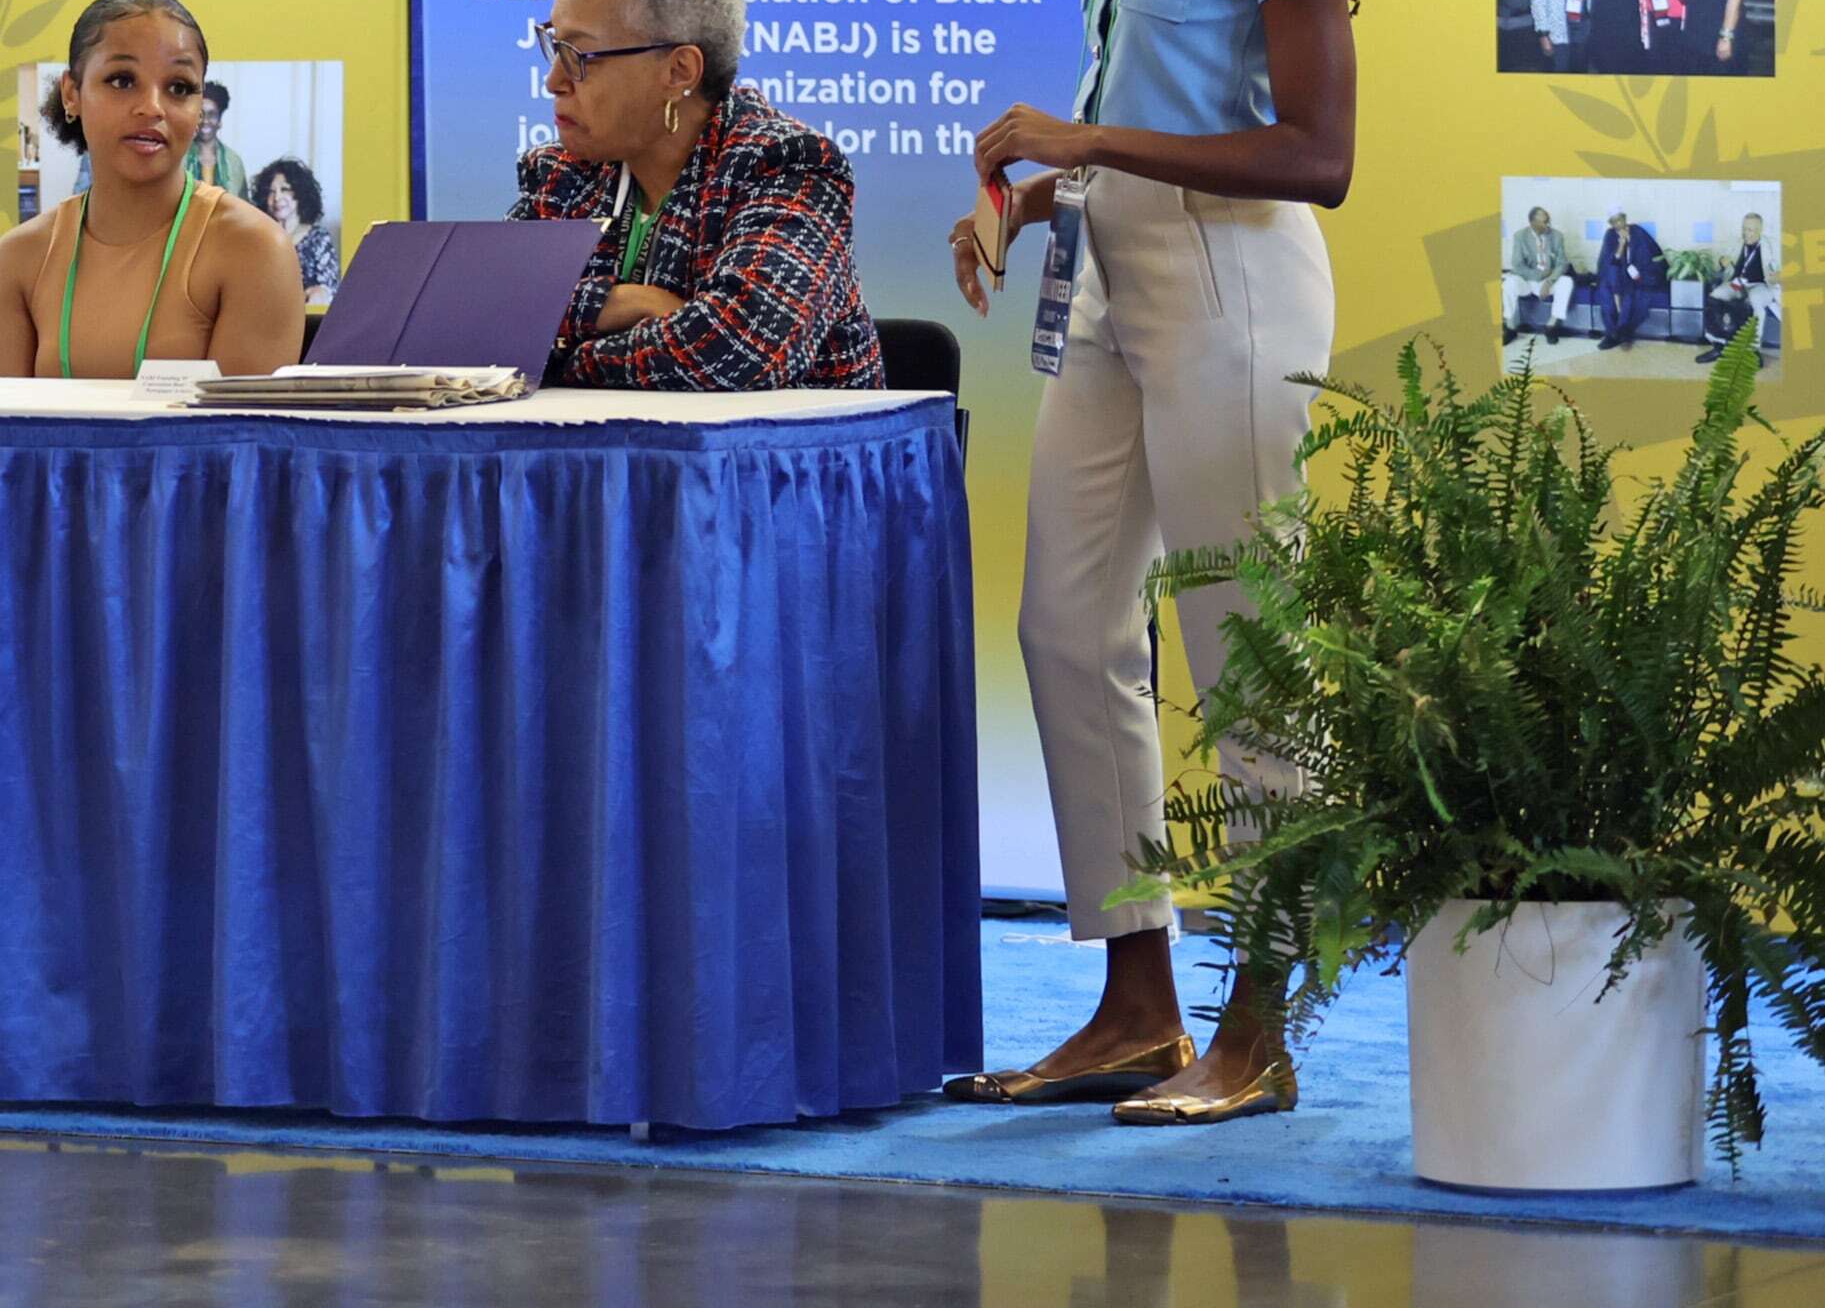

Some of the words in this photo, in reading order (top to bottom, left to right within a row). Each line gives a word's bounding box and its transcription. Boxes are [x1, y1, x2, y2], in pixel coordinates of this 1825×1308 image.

[741, 20, 878, 59] (NABJ)
[891, 20, 921, 55] is
[932, 20, 997, 55] the
[928, 71, 986, 105] for
[825, 121, 876, 154] lor
[889, 121, 923, 155] in
[936, 122, 974, 155] th
